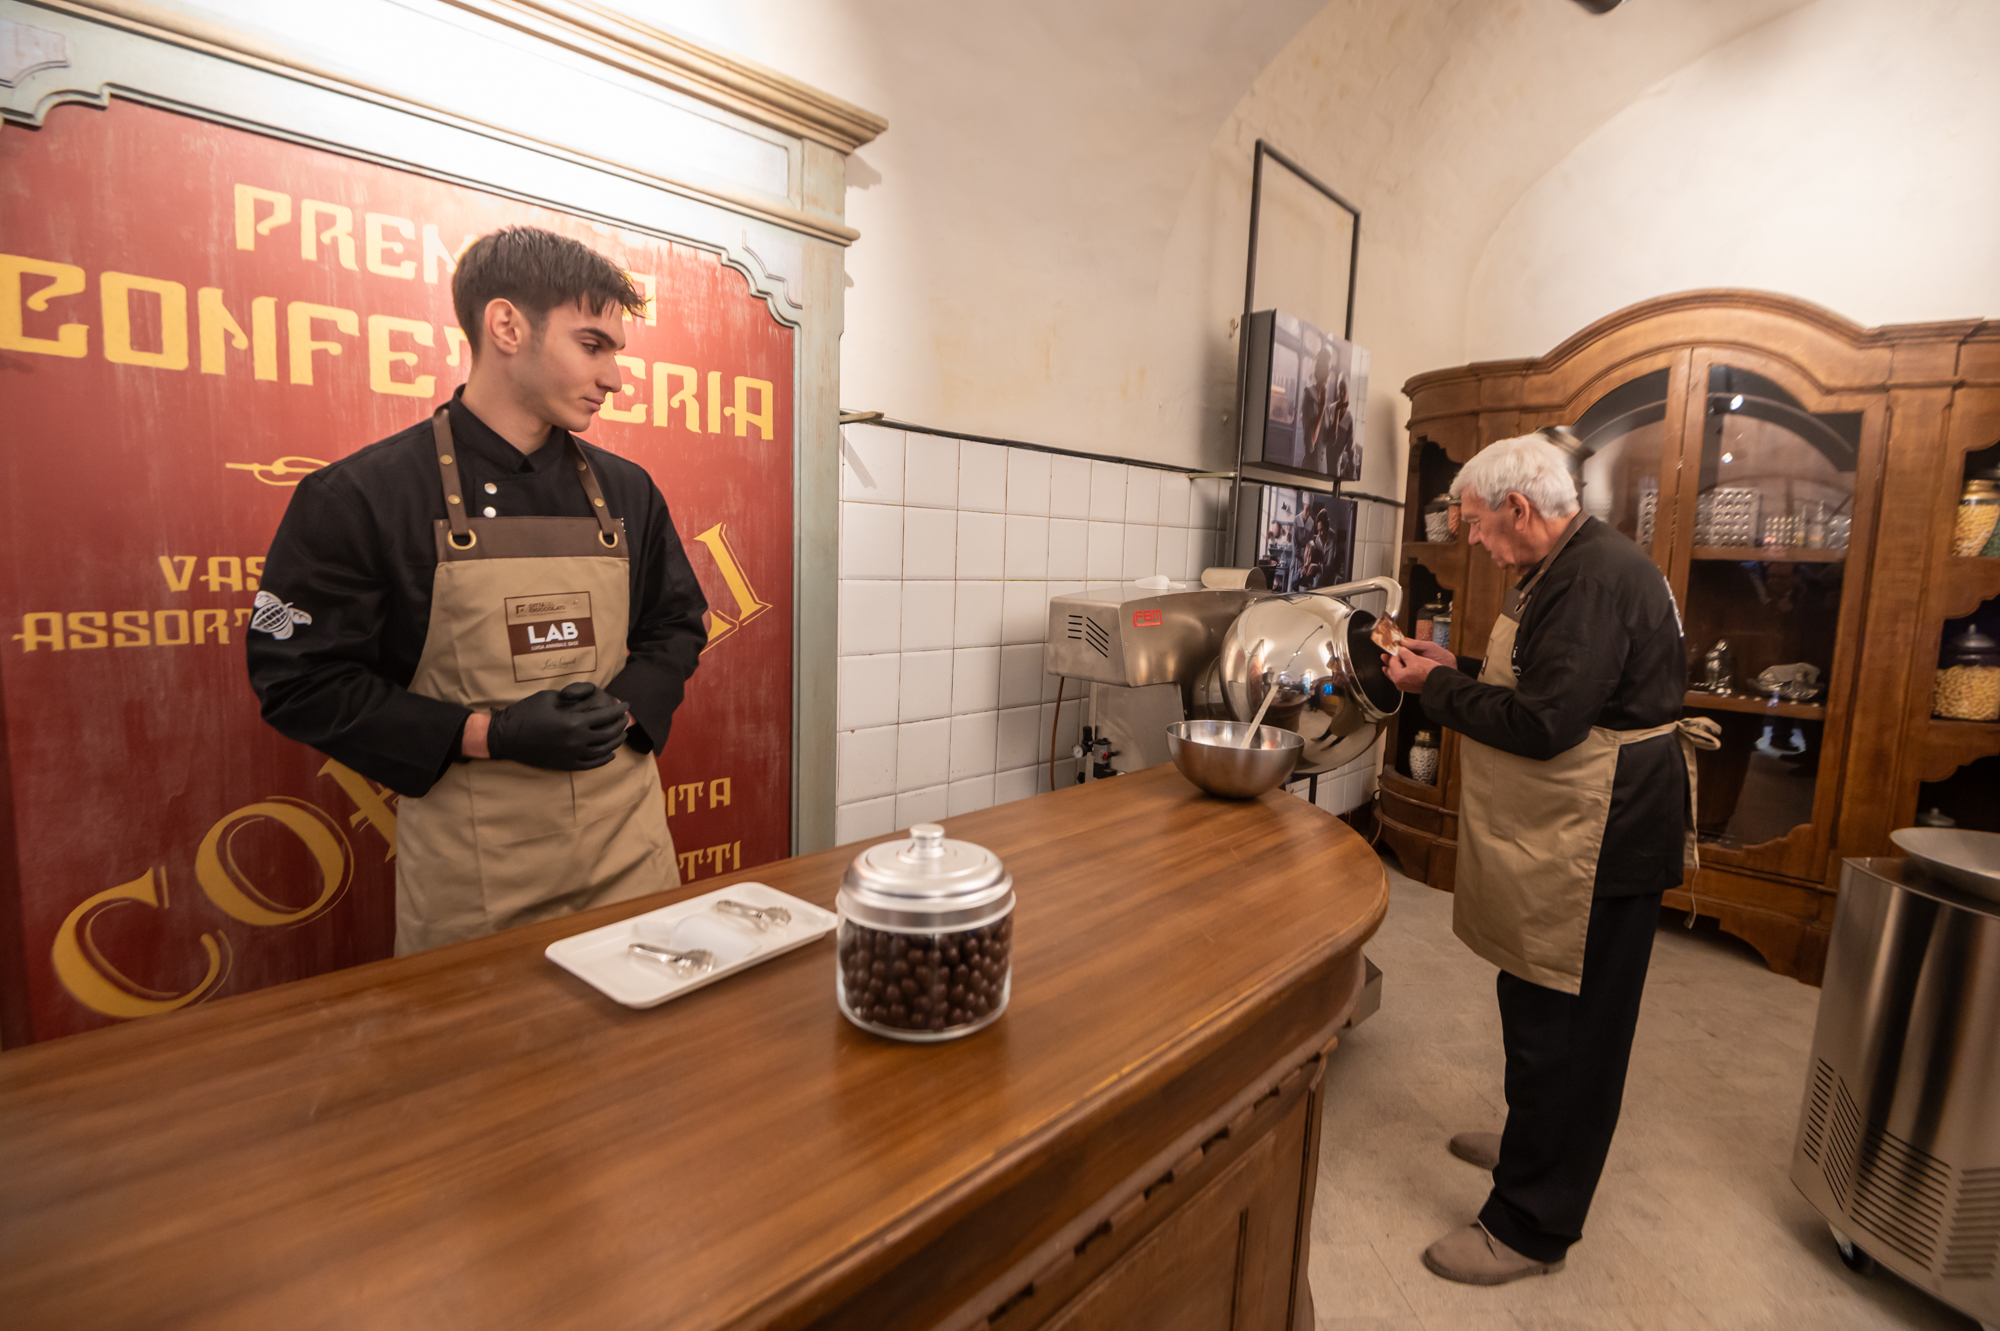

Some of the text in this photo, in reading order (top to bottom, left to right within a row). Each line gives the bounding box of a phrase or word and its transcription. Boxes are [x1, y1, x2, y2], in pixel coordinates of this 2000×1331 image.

[0, 253, 774, 441] CONFEERIA
[158, 555, 267, 592] VAS
[527, 621, 579, 644] LAB
